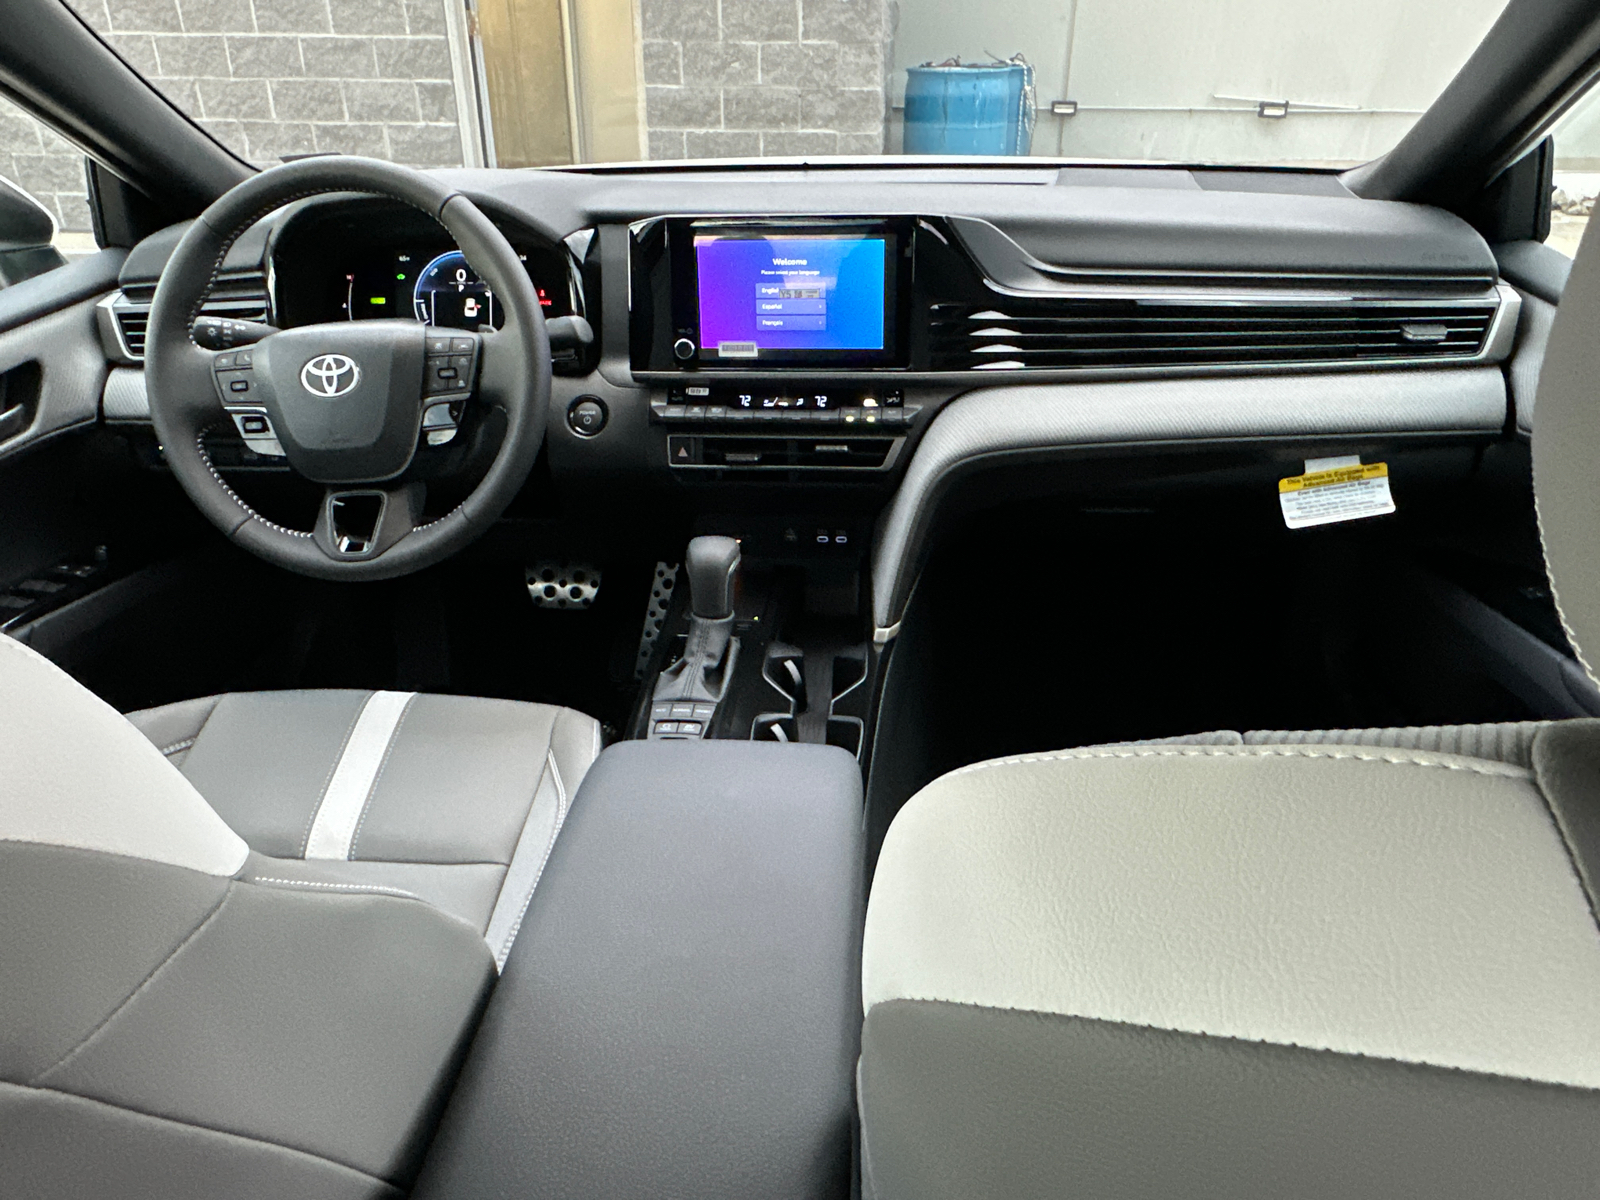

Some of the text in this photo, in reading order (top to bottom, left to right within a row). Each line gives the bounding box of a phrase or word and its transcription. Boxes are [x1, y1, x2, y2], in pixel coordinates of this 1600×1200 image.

[772, 258, 808, 266] Welcome
[455, 268, 467, 281] 0
[458, 284, 465, 292] P
[739, 394, 752, 407] 72
[814, 395, 828, 408] 72
